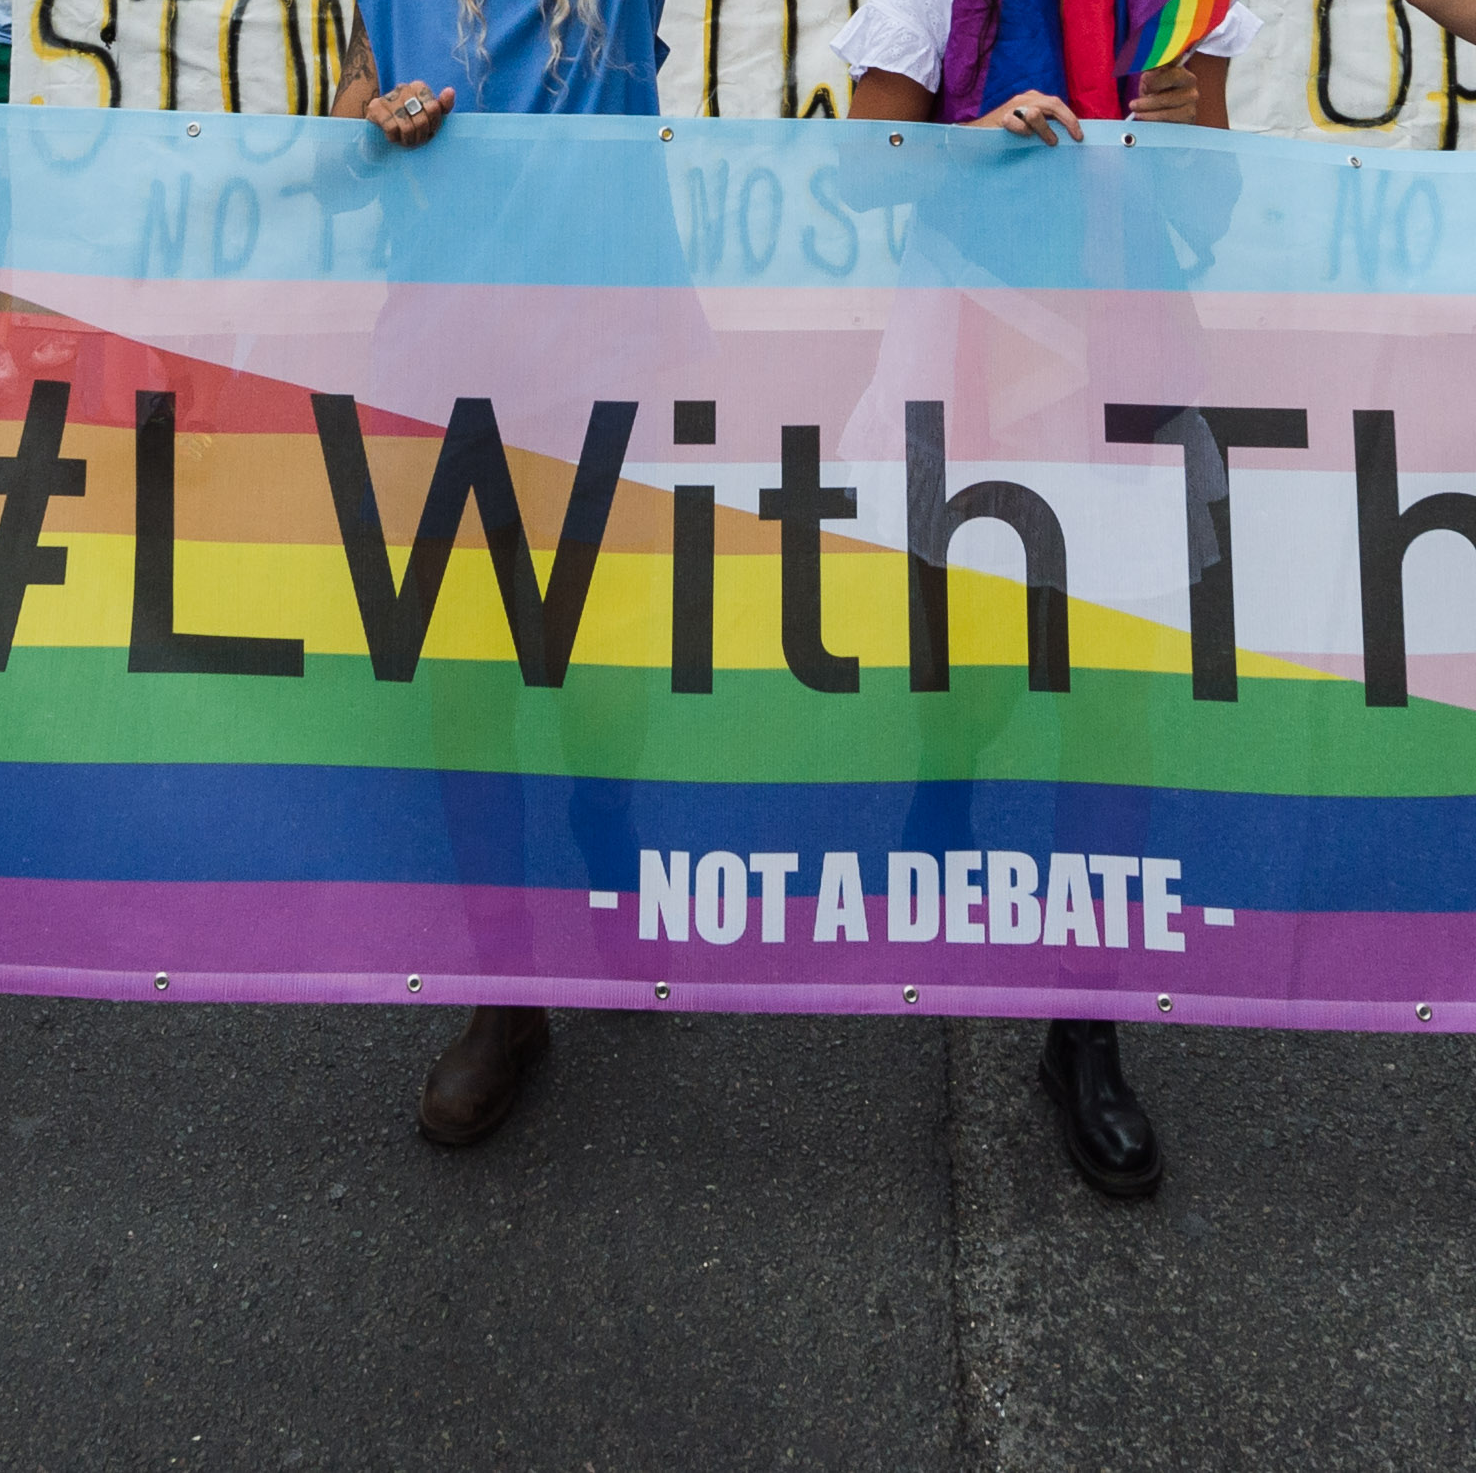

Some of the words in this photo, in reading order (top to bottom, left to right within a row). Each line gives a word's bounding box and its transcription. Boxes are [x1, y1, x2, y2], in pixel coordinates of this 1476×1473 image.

[638, 848, 799, 945] NOT
[813, 851, 869, 943] A
[887, 849, 1186, 953] DEBATE
